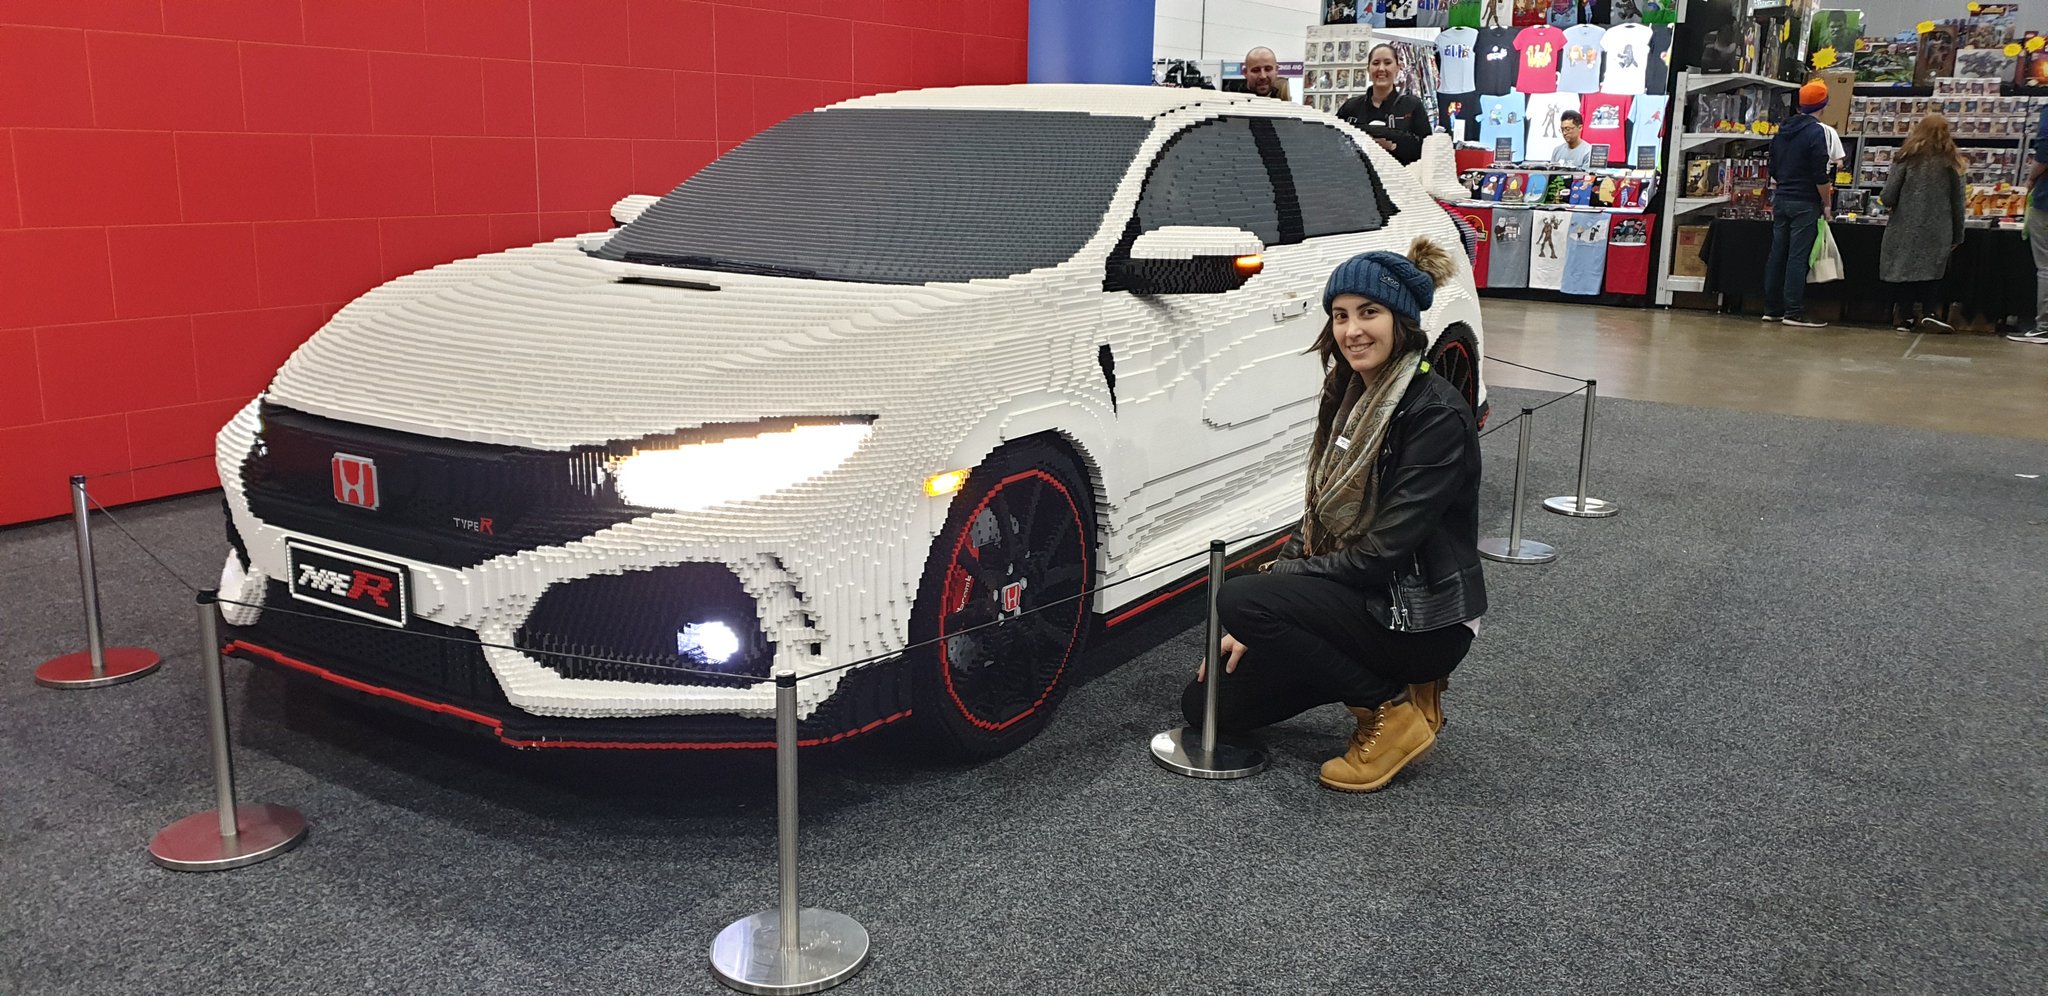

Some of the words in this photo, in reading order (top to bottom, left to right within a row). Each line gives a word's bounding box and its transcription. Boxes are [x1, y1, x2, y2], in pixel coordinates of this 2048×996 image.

[452, 517, 479, 532] TYPE
[480, 517, 494, 535] R
[298, 563, 351, 597] TYPE
[346, 570, 393, 608] R
